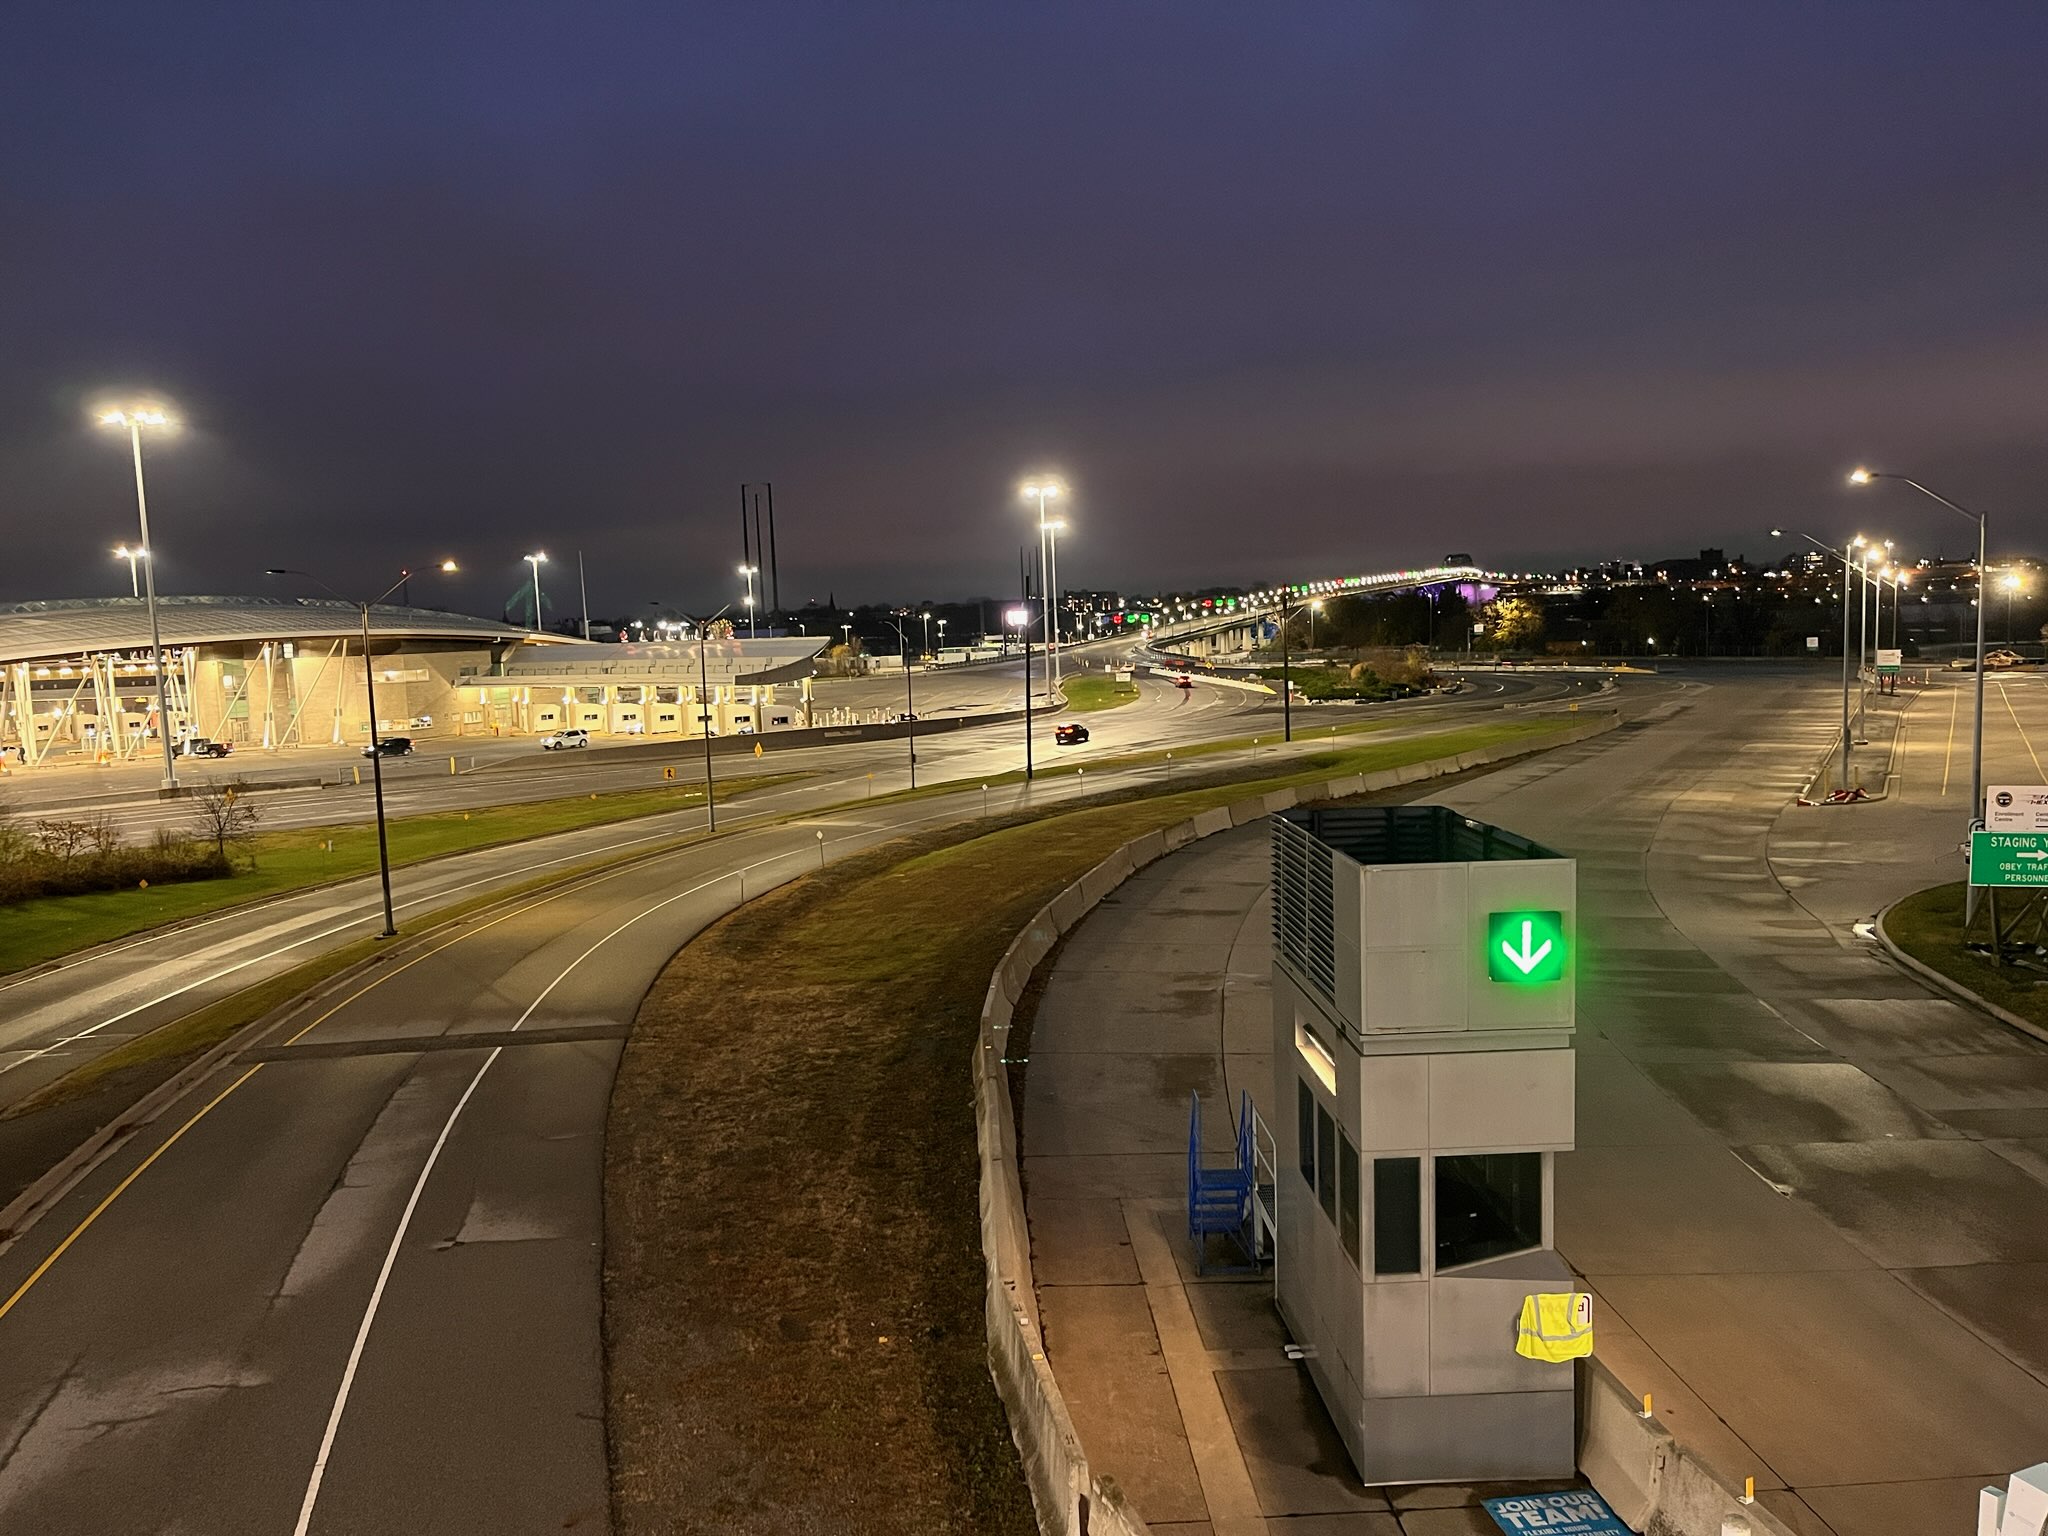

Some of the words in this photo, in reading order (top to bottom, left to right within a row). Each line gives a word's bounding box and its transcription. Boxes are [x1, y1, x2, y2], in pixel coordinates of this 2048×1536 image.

[1990, 836, 2037, 848] STAGING
[1999, 862, 2022, 871] OBEY
[1496, 1499, 1546, 1513] JOIN
[1548, 1494, 1596, 1507] OUR
[1499, 1503, 1609, 1529] TEAM!
